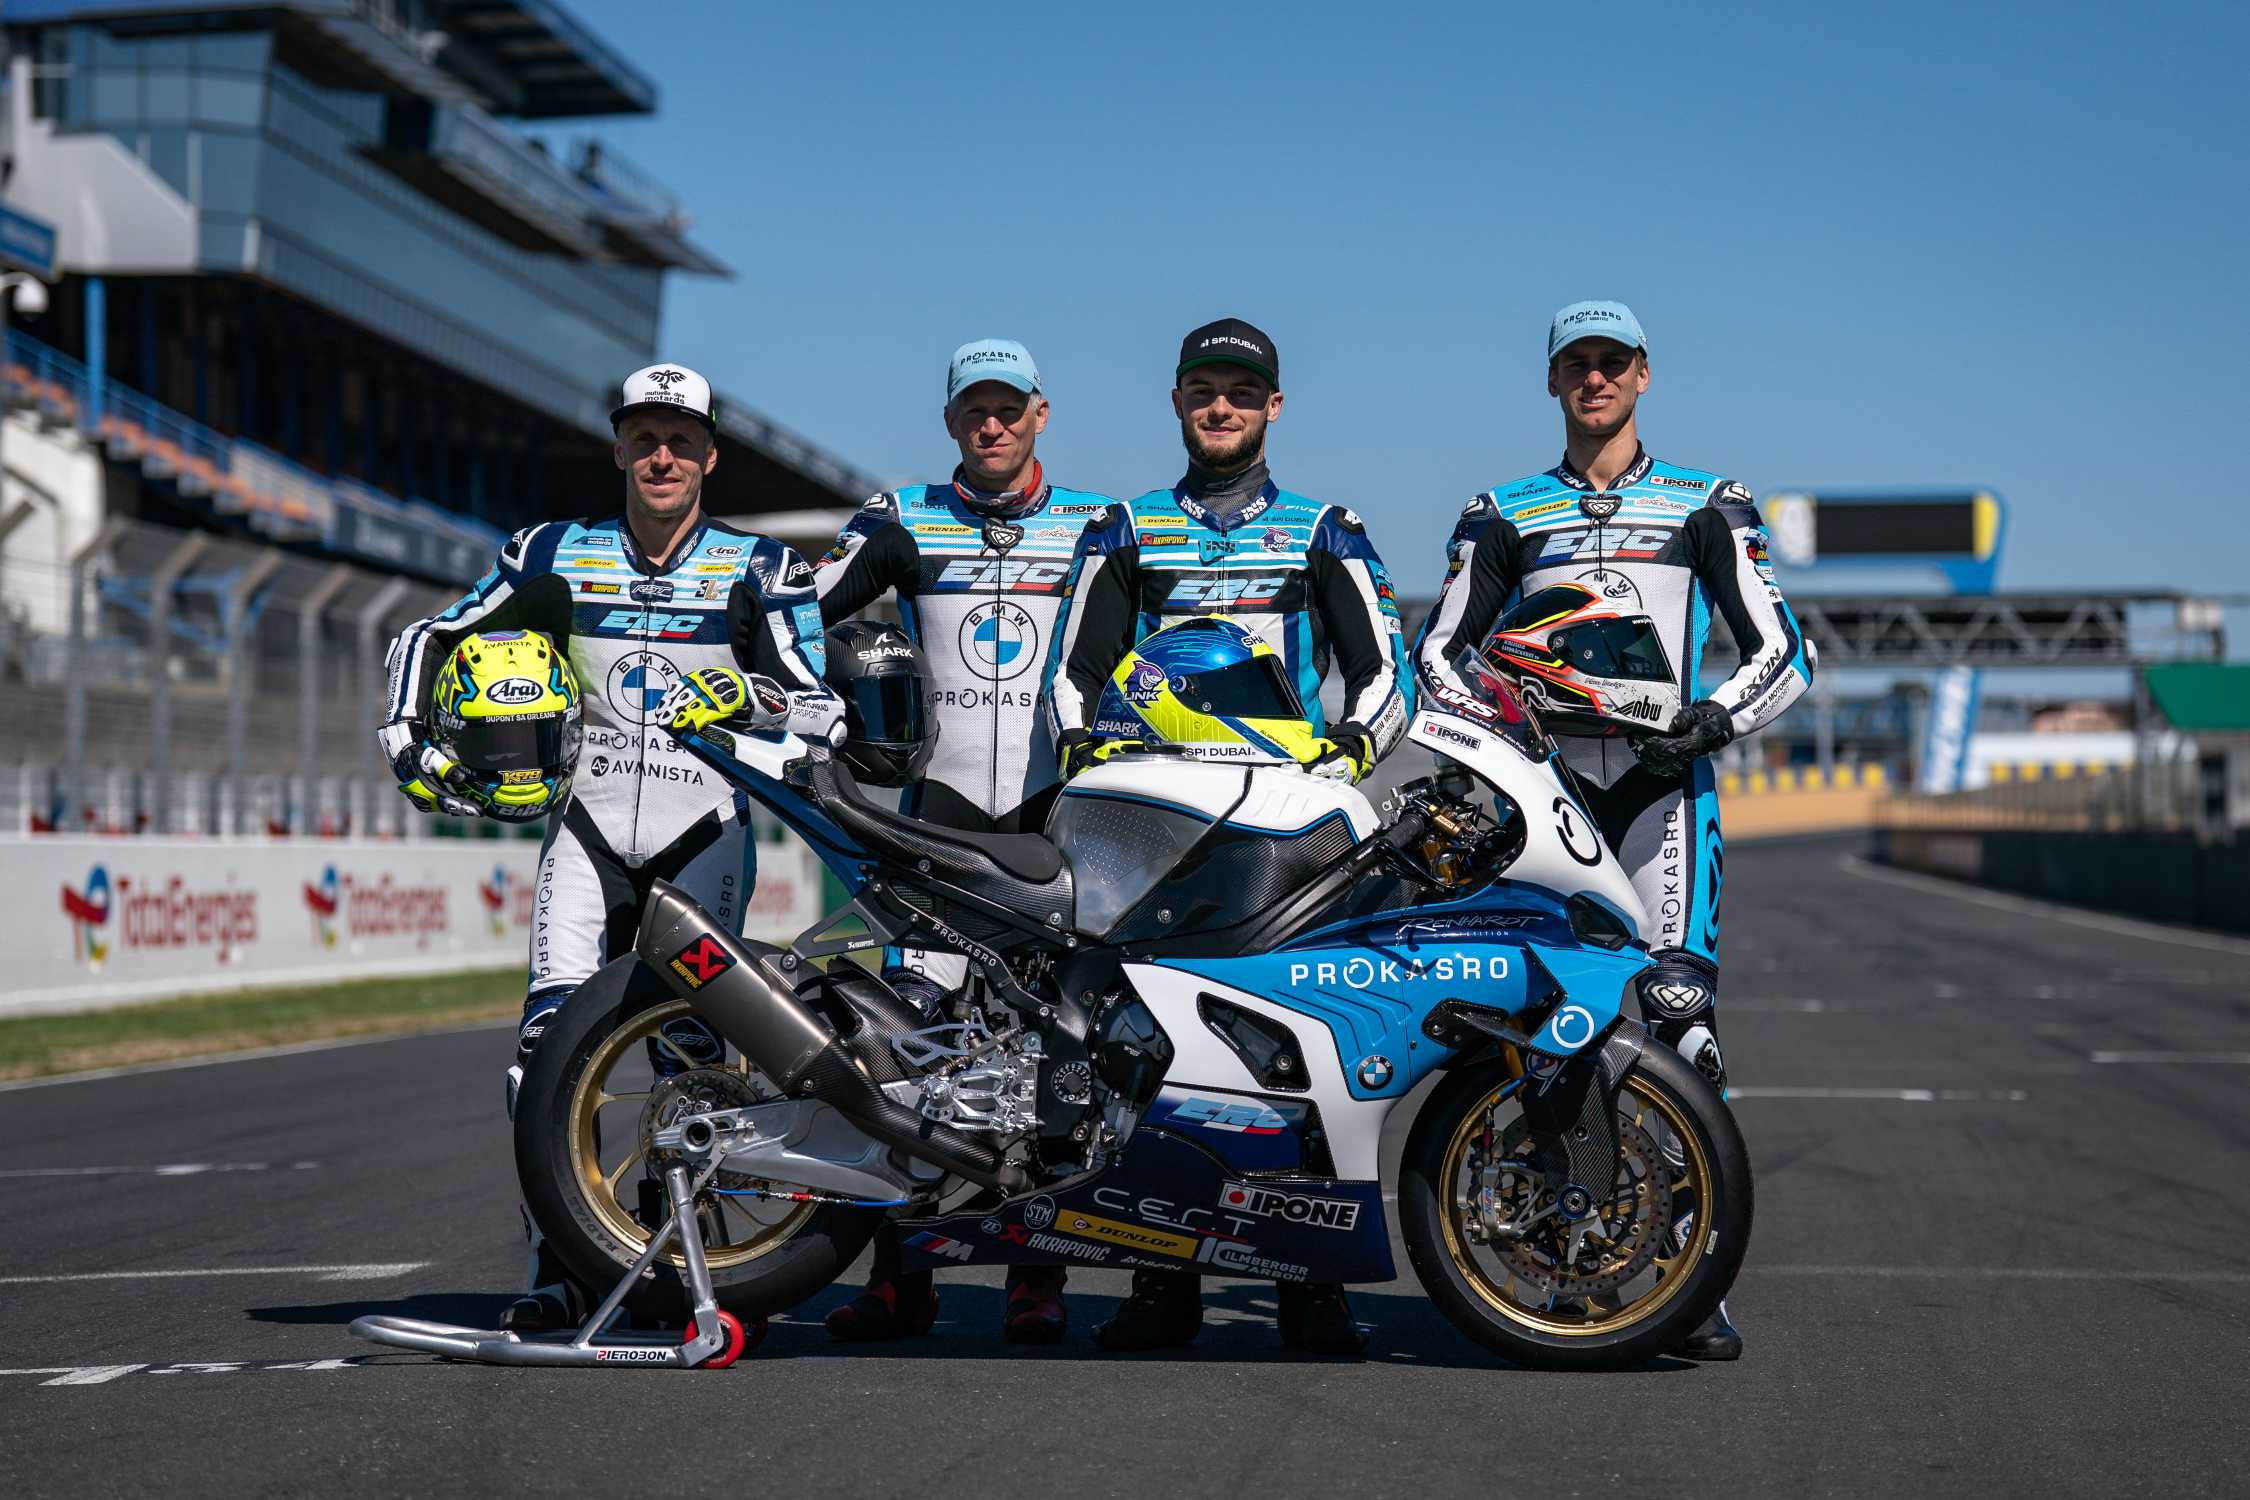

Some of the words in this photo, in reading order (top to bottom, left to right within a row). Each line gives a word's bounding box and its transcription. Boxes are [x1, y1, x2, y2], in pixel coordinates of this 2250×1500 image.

[1211, 336, 1228, 345] SPI
[1229, 336, 1261, 354] DUBAI
[644, 395, 685, 404] motards
[1507, 485, 1552, 499] SHARK
[1662, 478, 1706, 489] IPONE
[1526, 500, 1568, 516] DUNLOP
[677, 532, 699, 563] RST
[713, 546, 740, 556] Arai
[787, 561, 811, 582] RS
[939, 559, 1070, 583] ERC
[1168, 577, 1286, 601] ERC
[1593, 572, 1632, 594] MW
[968, 605, 1028, 627] BMW
[483, 641, 532, 650] AVANISTA
[857, 647, 914, 660] SHARK
[617, 654, 674, 677] BMW
[1422, 661, 1445, 690] IXO
[490, 679, 537, 699] Arai
[935, 689, 1041, 709] PROKAS
[1124, 691, 1157, 701] LINK
[1752, 699, 1768, 717] BMW
[1768, 669, 1795, 701] MOTORRAD
[485, 714, 515, 722] DUPONT
[791, 708, 821, 721] ORSPORT
[1096, 720, 1142, 734] SHARK
[588, 732, 687, 753] PROKAS
[1437, 727, 1479, 750] IPONE
[1185, 747, 1206, 757] SPI
[1209, 747, 1251, 757] DUBAI
[612, 759, 705, 786] AVANISTA
[1661, 809, 1681, 951] PROKASRO
[536, 857, 556, 978] PROKASRO
[1398, 914, 1544, 934] REINHARDT
[932, 923, 997, 967] PROKASRO
[1291, 956, 1509, 989] PROKASRO
[523, 1026, 545, 1037] RS
[669, 1032, 713, 1047] RST
[1026, 1205, 1052, 1222] STM
[1250, 1187, 1360, 1231] IPONE
[1097, 1225, 1179, 1249] DUNLOP
[597, 1350, 667, 1361] PIEROBON
